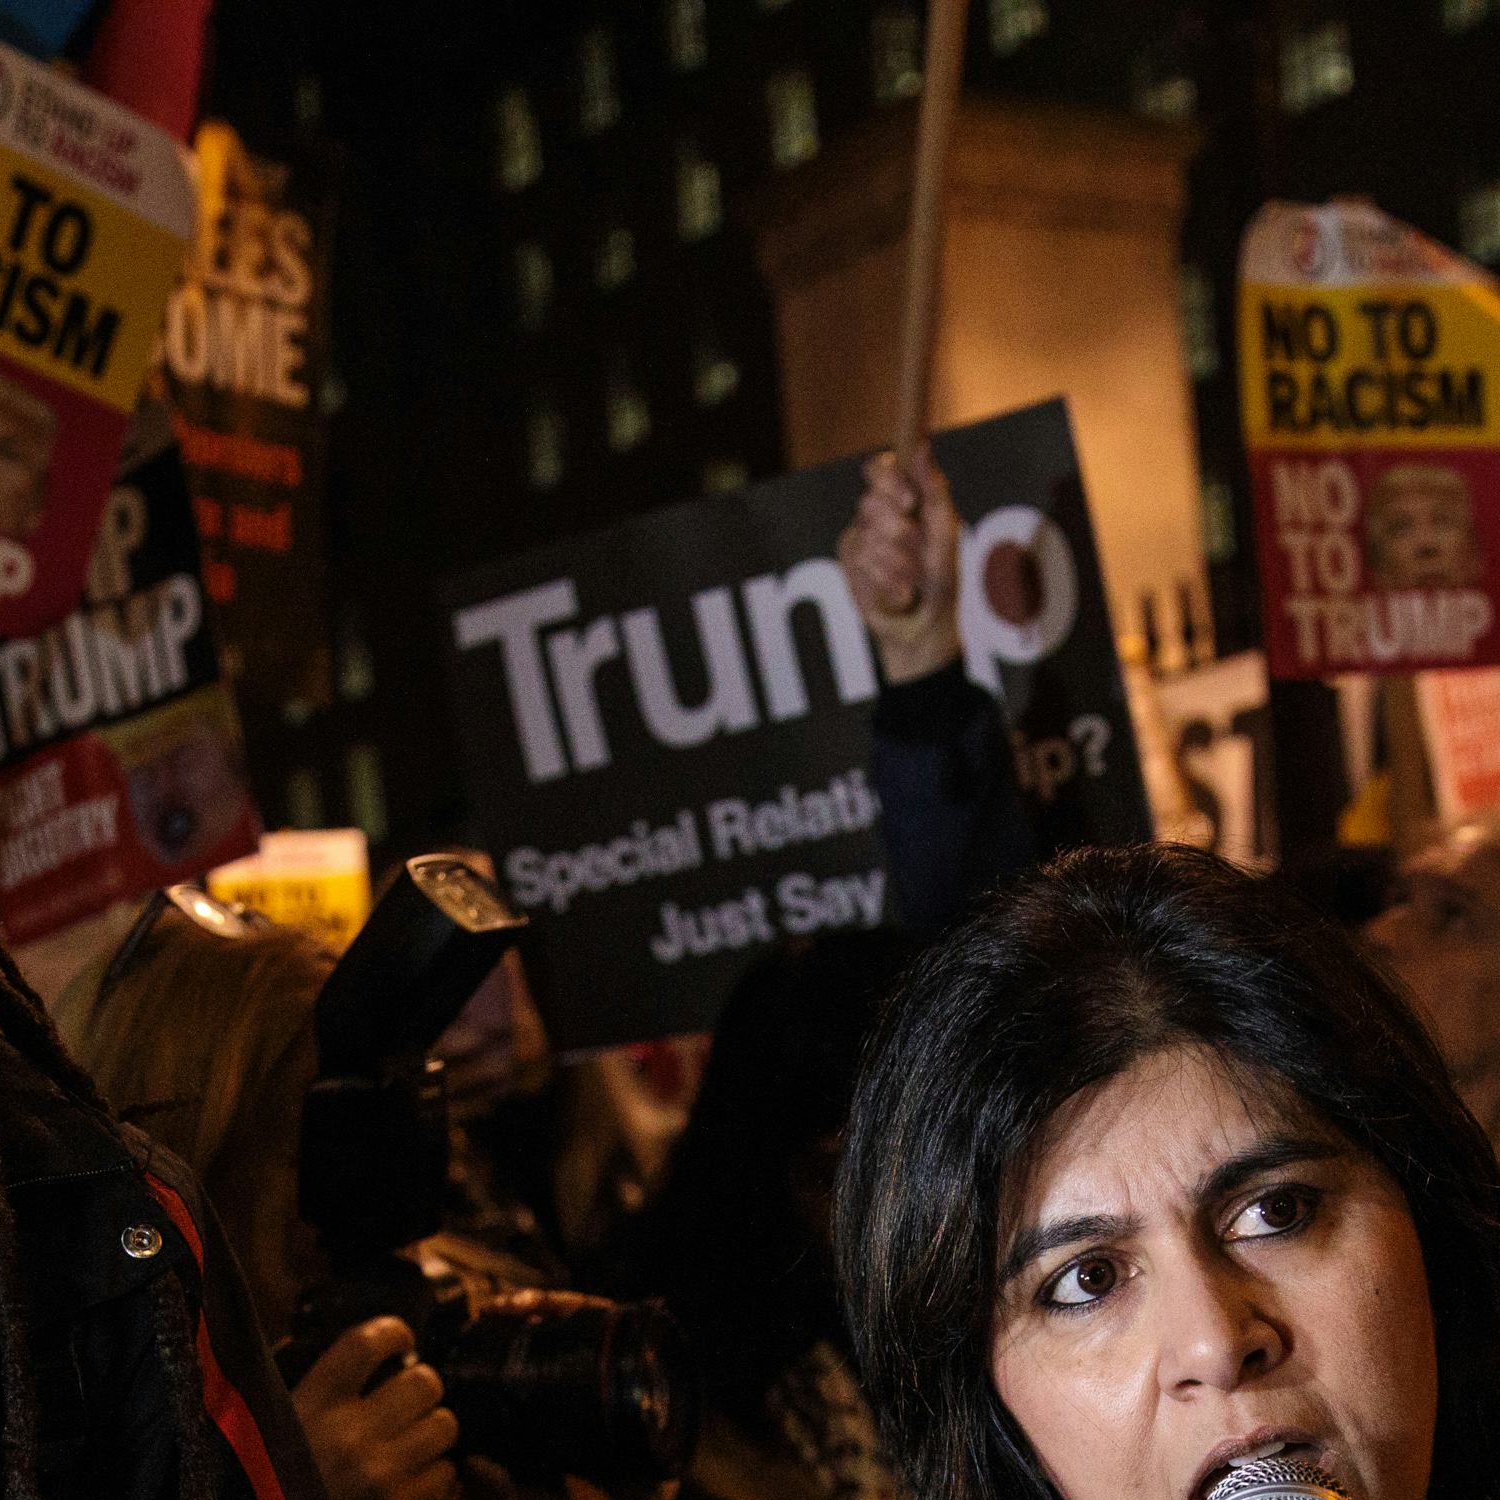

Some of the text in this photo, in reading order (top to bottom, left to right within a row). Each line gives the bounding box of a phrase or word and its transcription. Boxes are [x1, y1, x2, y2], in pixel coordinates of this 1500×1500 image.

[6, 177, 94, 274] TO
[1262, 301, 1439, 363] NO TO
[1265, 369, 1487, 433] RACISM
[1269, 460, 1361, 527] NO
[1281, 528, 1363, 593] TO
[1285, 589, 1496, 664] TRUMP
[502, 808, 704, 916] Special
[648, 864, 888, 967] Just Say
